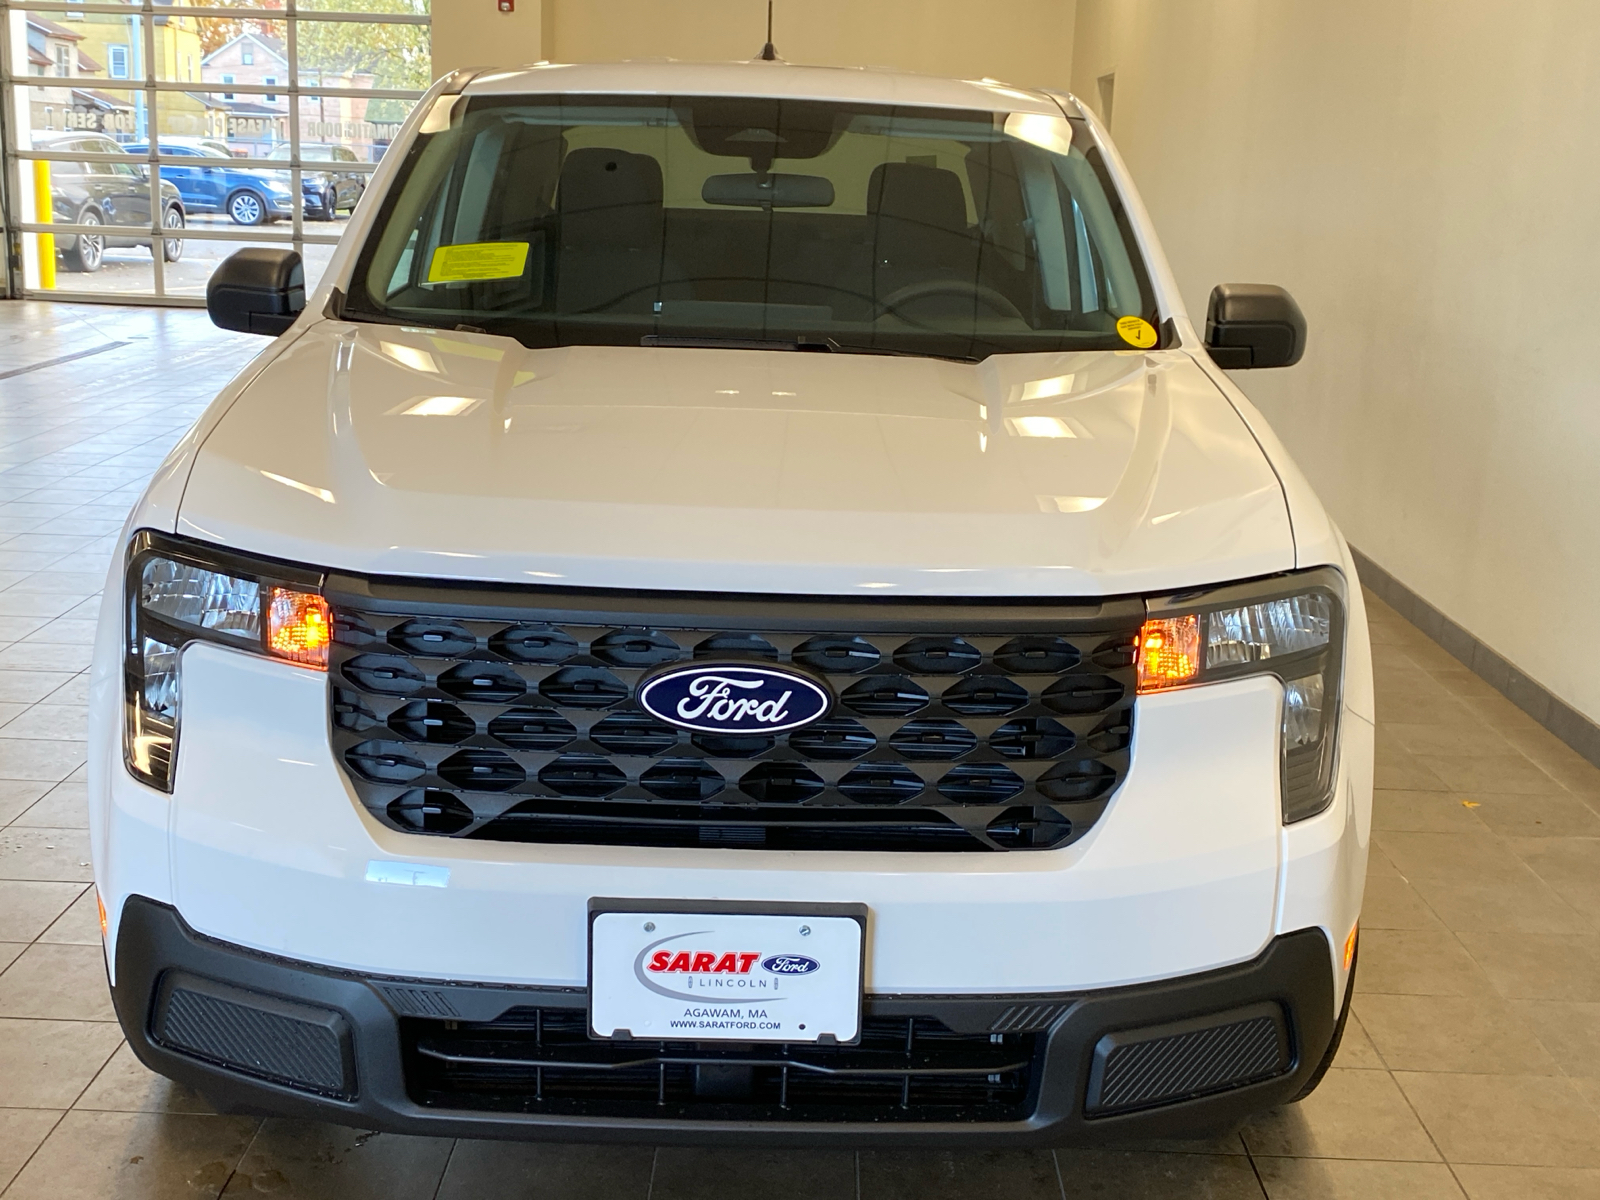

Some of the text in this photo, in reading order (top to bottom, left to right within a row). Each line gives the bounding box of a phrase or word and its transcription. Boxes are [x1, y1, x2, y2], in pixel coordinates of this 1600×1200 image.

[676, 675, 793, 723] Ford
[646, 949, 762, 974] SARAT
[771, 955, 809, 973] Ford
[699, 978, 768, 988] LINCOLN
[683, 1008, 768, 1020] AGAWAM, MA
[670, 1020, 781, 1030] WWW.SARATFORD.COM
